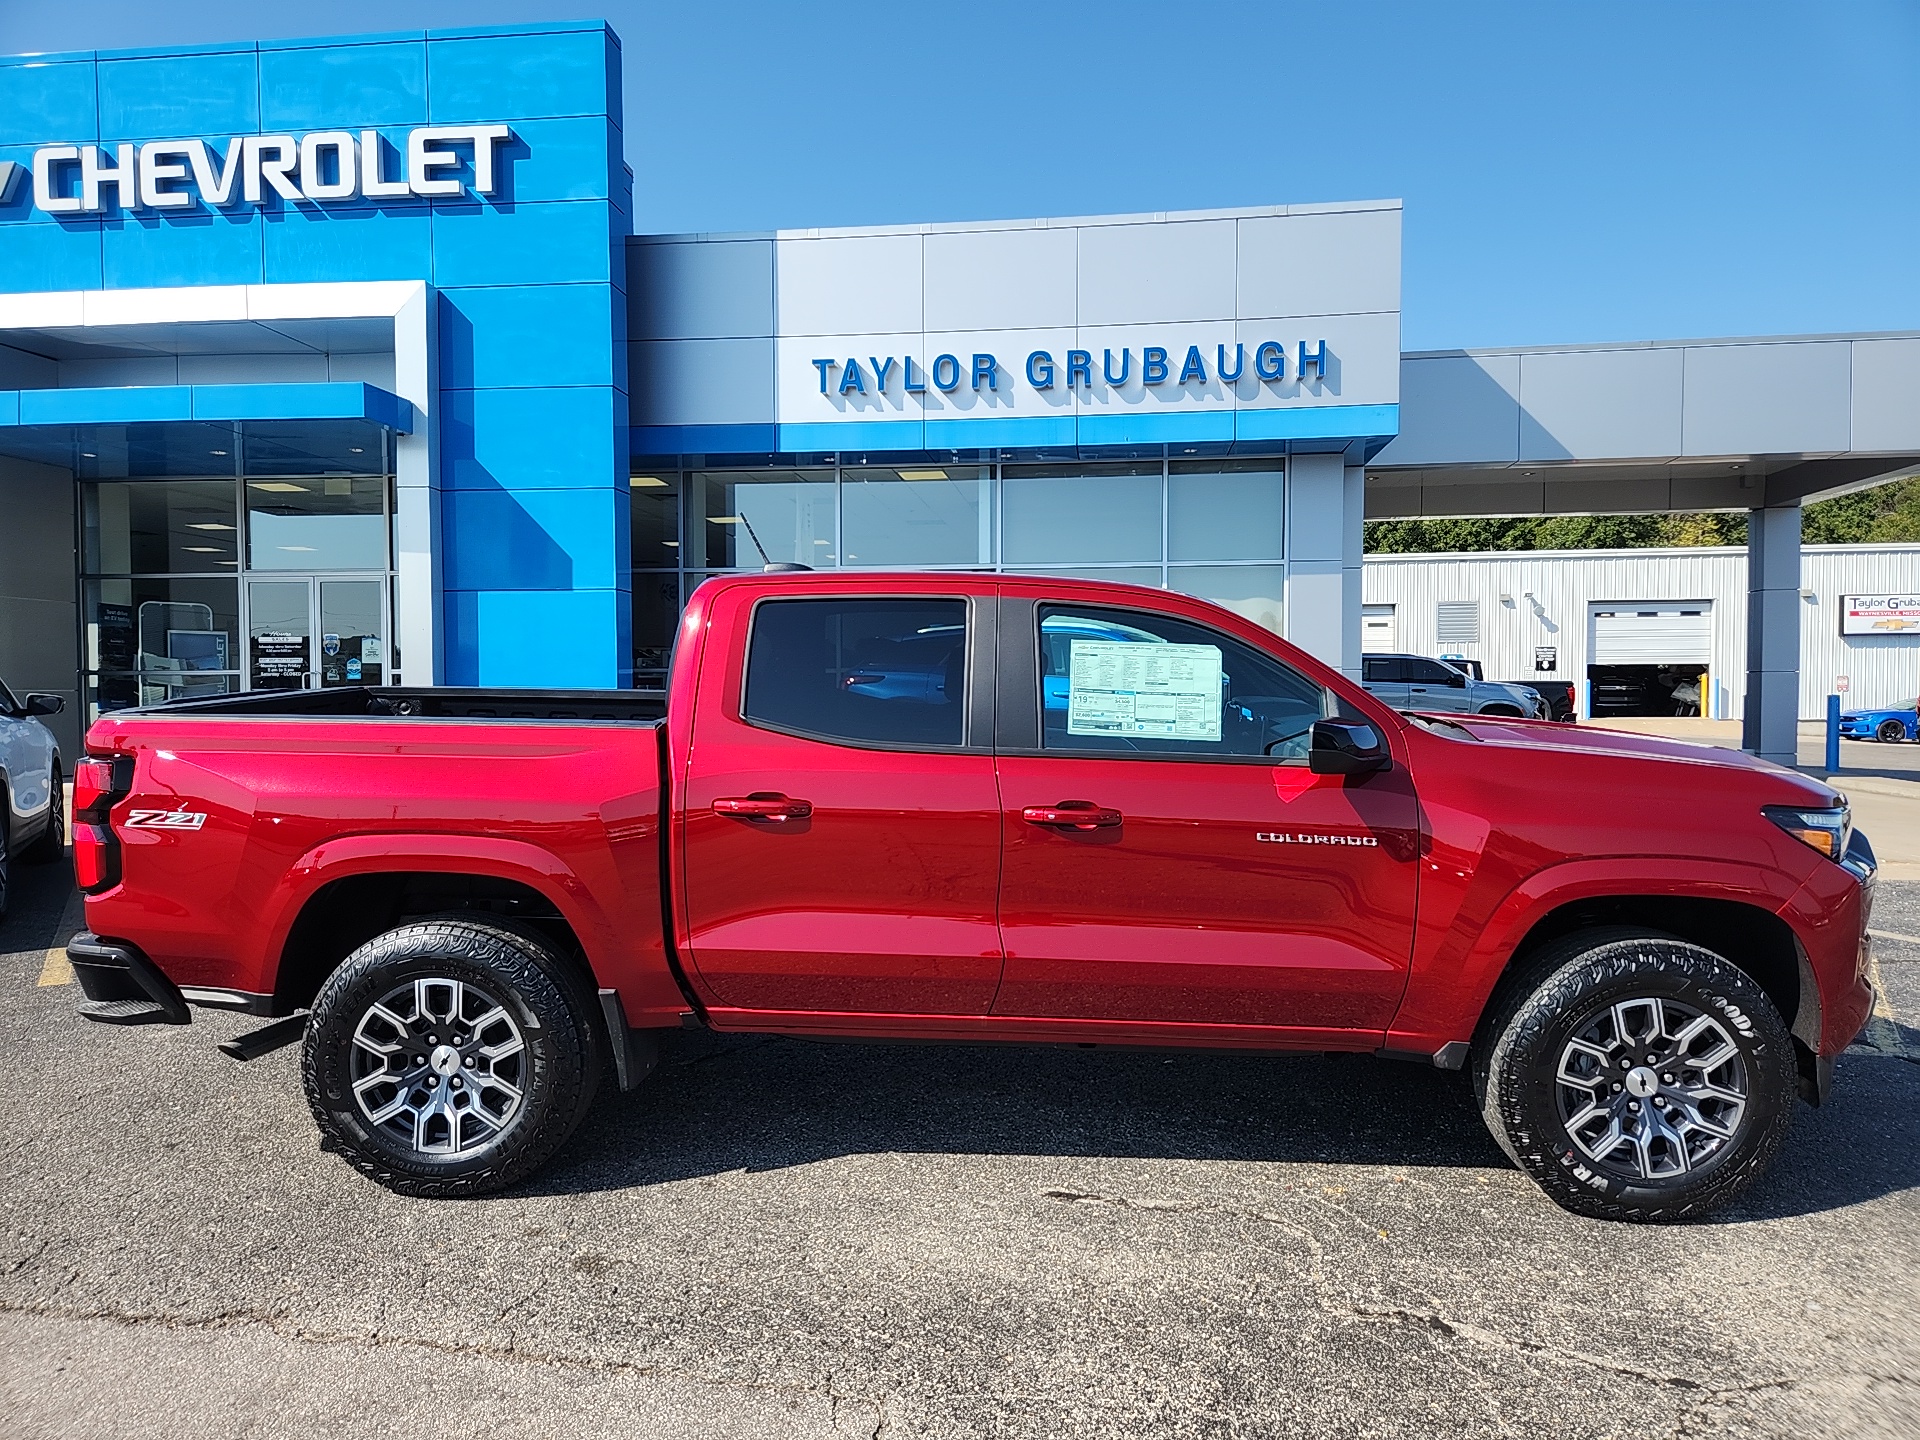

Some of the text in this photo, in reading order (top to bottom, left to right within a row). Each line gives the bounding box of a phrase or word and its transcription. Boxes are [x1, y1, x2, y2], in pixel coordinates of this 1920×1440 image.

[33, 125, 511, 212] CHEVROLET
[812, 339, 1328, 395] TAYLOR GRUBAUGH
[1849, 597, 1885, 610] Taylor
[1256, 832, 1378, 847] COLORADO
